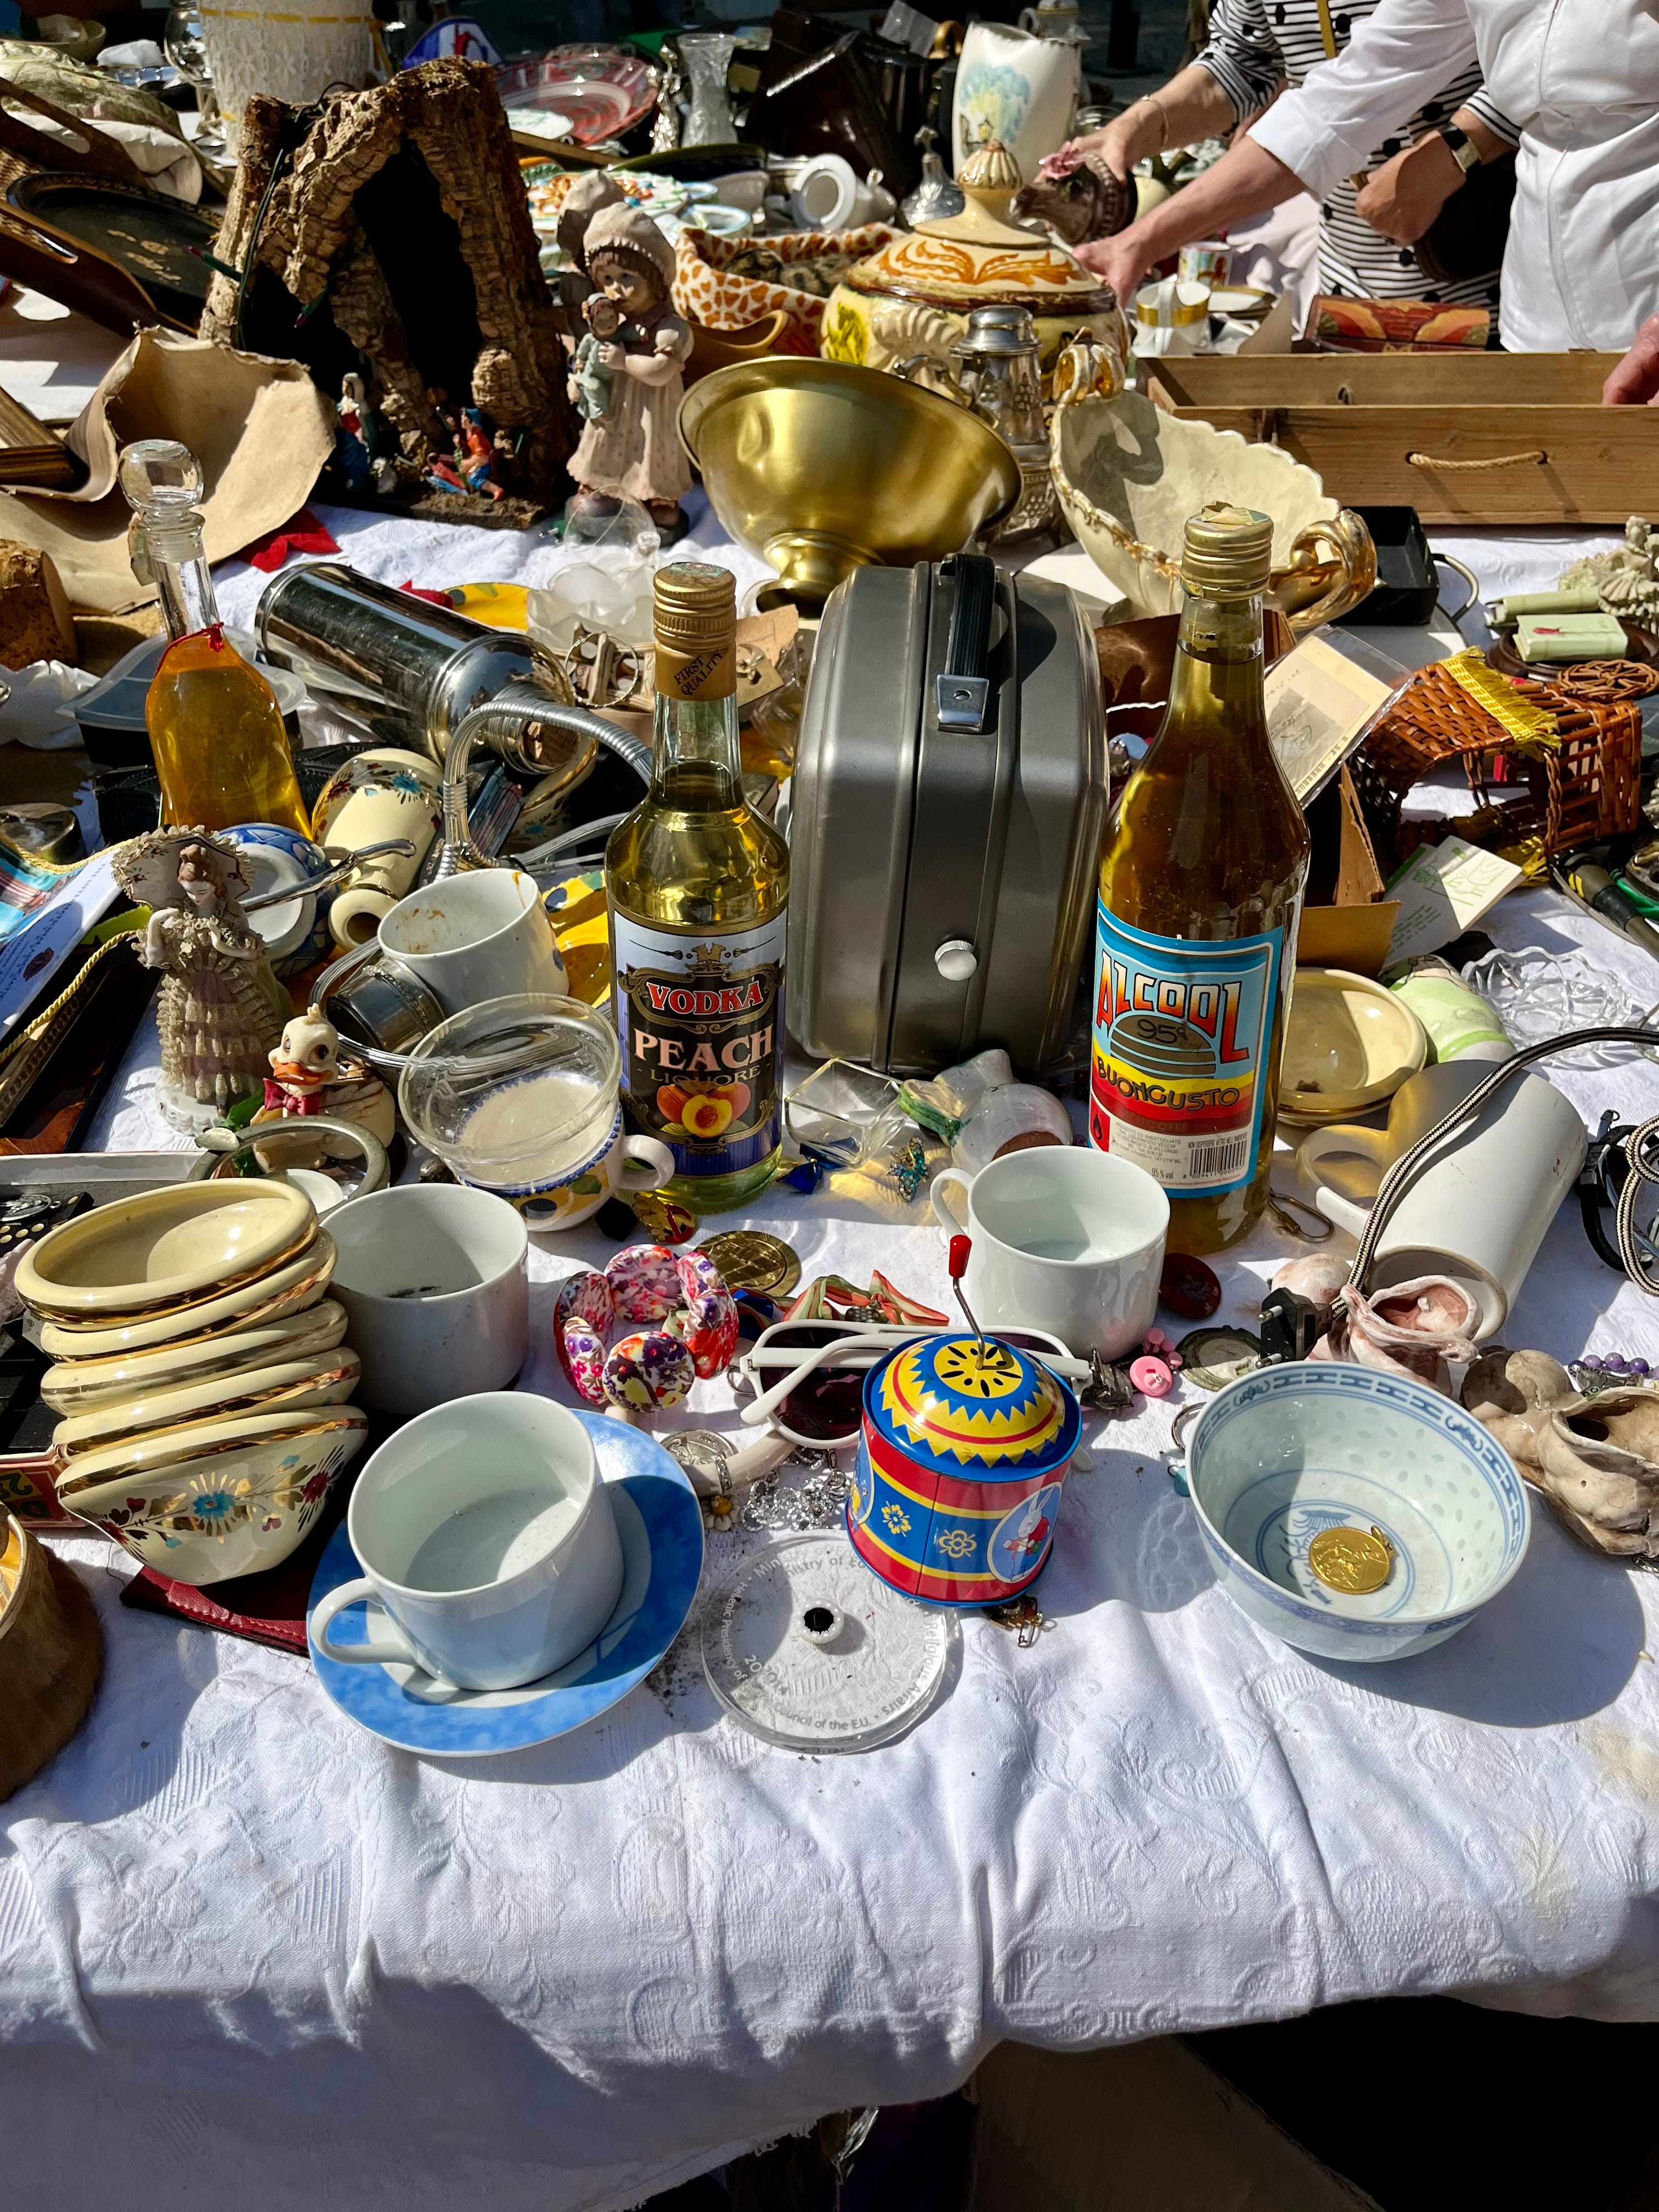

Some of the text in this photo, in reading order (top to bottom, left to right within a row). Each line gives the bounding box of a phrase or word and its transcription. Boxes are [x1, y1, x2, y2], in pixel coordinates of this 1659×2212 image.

[674, 655, 704, 685] FIRST
[681, 649, 723, 696] QUALITY
[646, 980, 763, 1014] VODKA
[1097, 948, 1250, 1064] ALCOOL
[634, 1024, 773, 1071] PEACH
[650, 1065, 760, 1085] LIQUORE
[1097, 1055, 1240, 1111] BUONGUSTO
[1116, 1121, 1137, 1136] PRODOTTO
[1144, 1135, 1181, 1145] IMBOTTIGLIATO
[1152, 1167, 1159, 1177] 95
[1165, 1171, 1173, 1179] vol
[720, 1619, 738, 1669] Presidency
[733, 1669, 748, 1680] of
